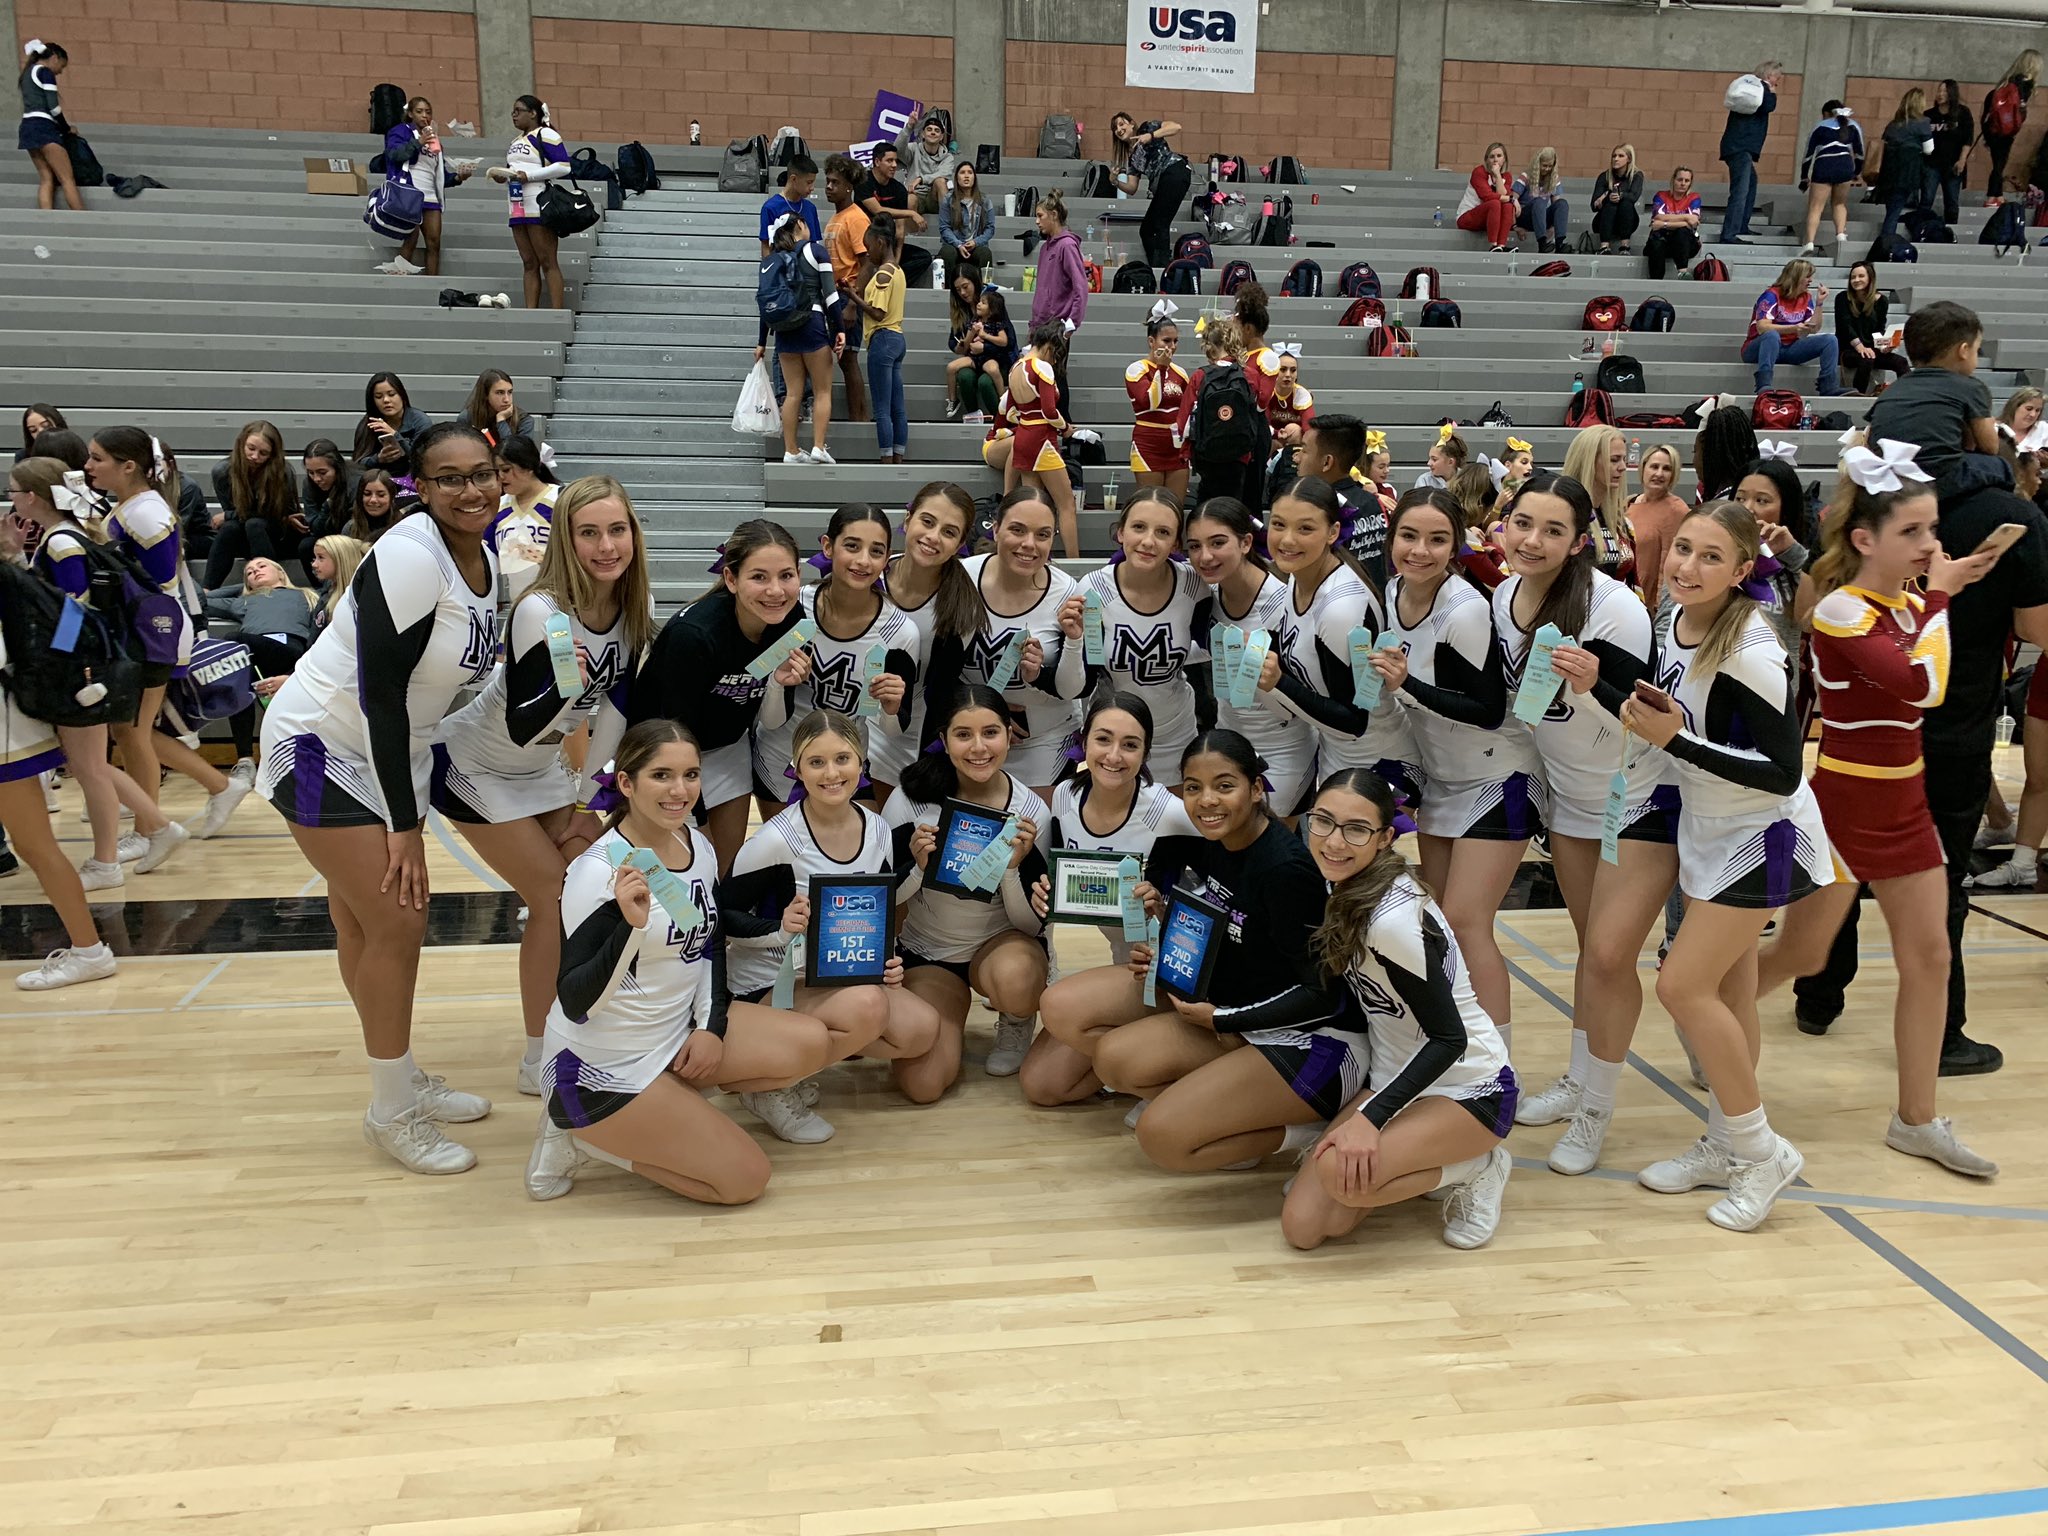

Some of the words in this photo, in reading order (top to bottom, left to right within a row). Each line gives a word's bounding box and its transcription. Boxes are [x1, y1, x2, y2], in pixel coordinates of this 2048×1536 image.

[840, 935, 866, 948] 1ST
[827, 949, 876, 963] PLACE
[1170, 945, 1191, 963] 2ND
[1163, 953, 1194, 979] PLACE
